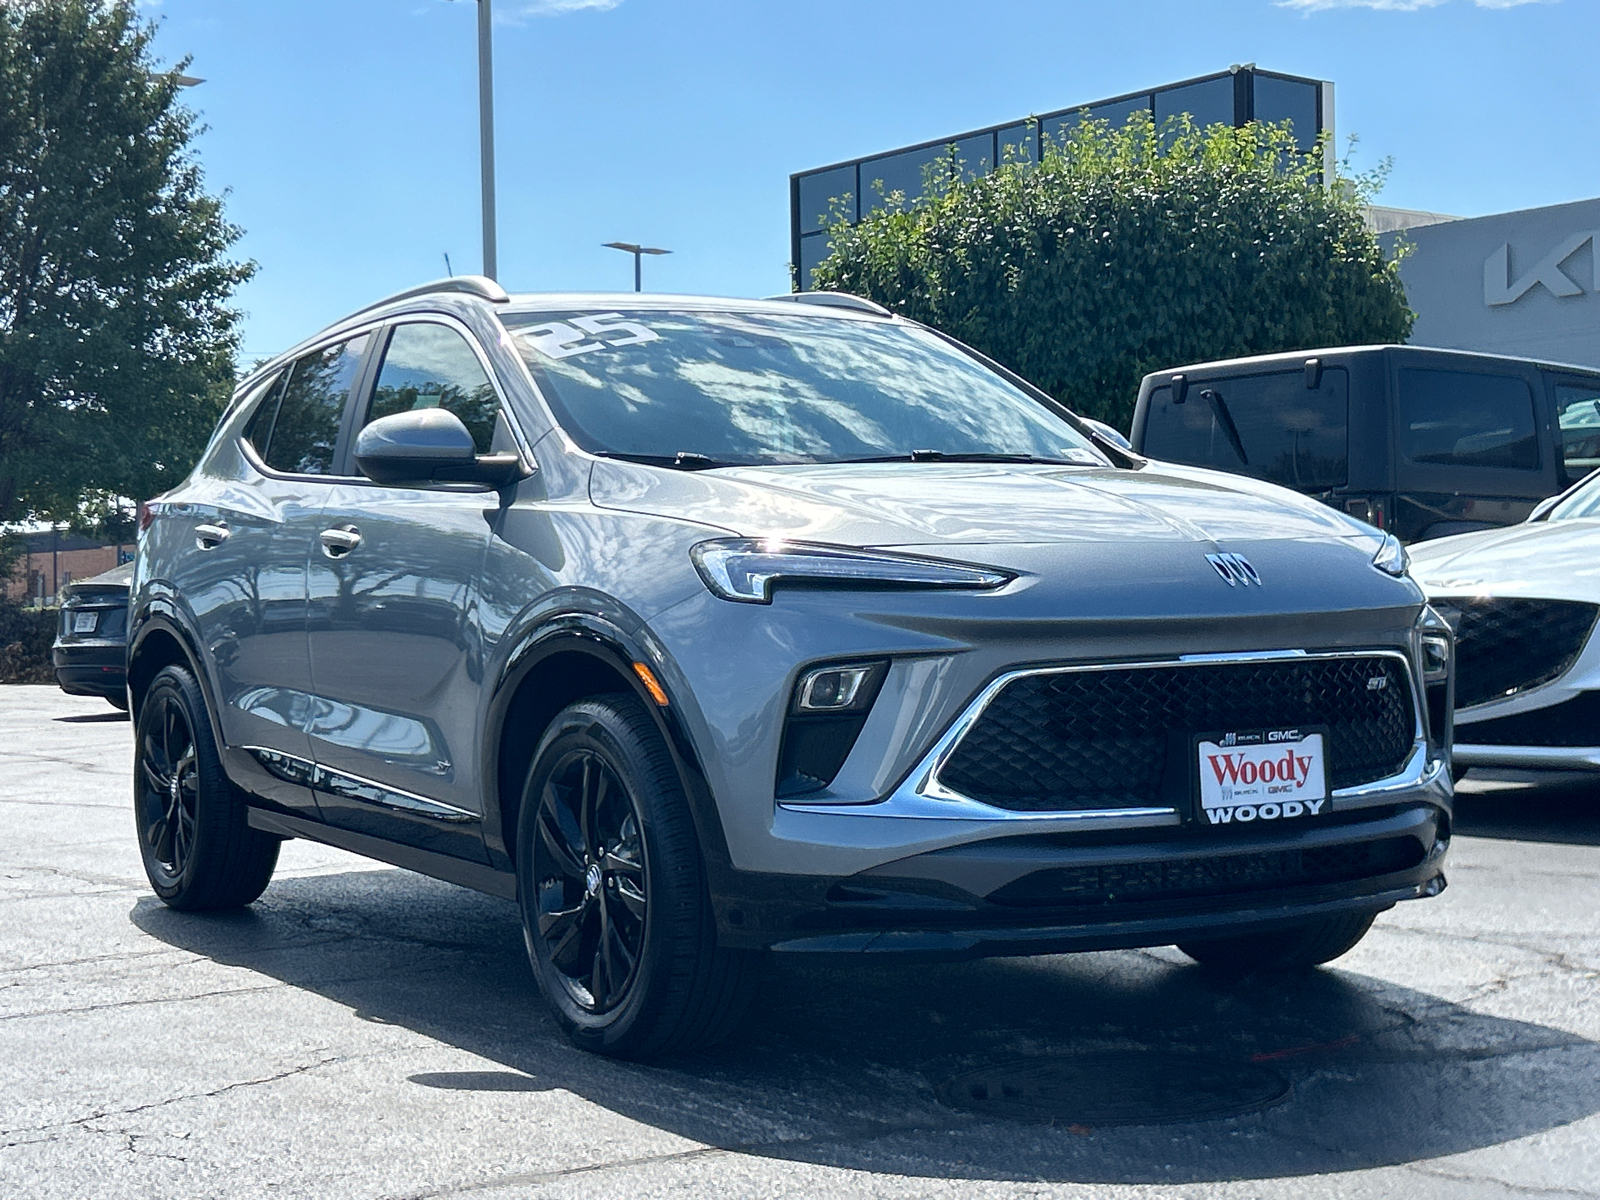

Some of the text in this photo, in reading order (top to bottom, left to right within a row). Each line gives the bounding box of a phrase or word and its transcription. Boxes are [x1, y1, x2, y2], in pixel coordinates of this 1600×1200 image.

[508, 312, 659, 359] 25
[1268, 730, 1298, 741] GMC
[1207, 749, 1313, 788] Woody
[1268, 784, 1293, 794] GMC
[1206, 799, 1325, 825] WOODY
